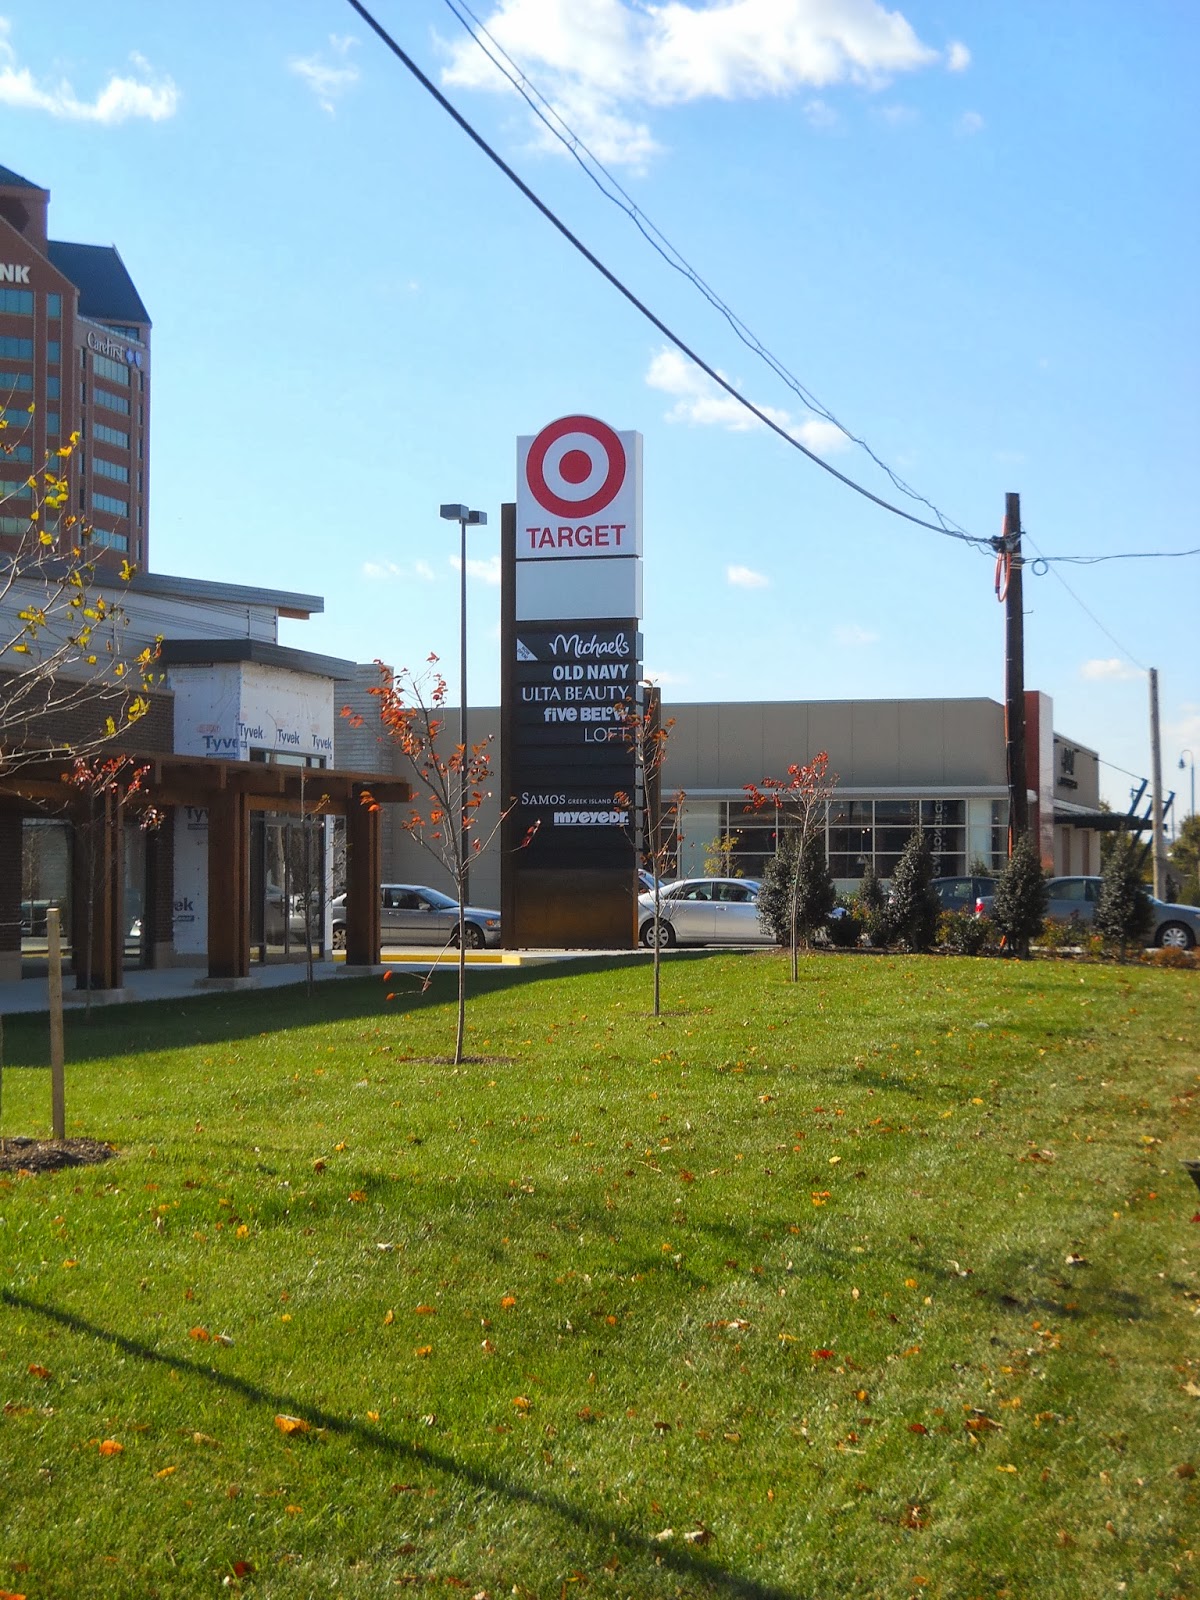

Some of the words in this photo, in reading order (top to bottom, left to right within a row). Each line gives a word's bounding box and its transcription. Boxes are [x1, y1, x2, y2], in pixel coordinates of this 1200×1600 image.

[87, 331, 124, 362] CareFirst
[526, 524, 626, 548] TARGET
[549, 633, 630, 658] Michaels
[553, 665, 584, 681] OLD
[588, 664, 629, 680] NAVY
[522, 686, 561, 701] ULTA
[566, 686, 629, 701] BEAUTY
[544, 707, 577, 722] five
[238, 723, 264, 742] Tyvek
[277, 729, 300, 745] Tyvek
[584, 727, 629, 742] LOFT
[312, 734, 332, 750] Tyvek
[521, 792, 566, 805] SAMOS
